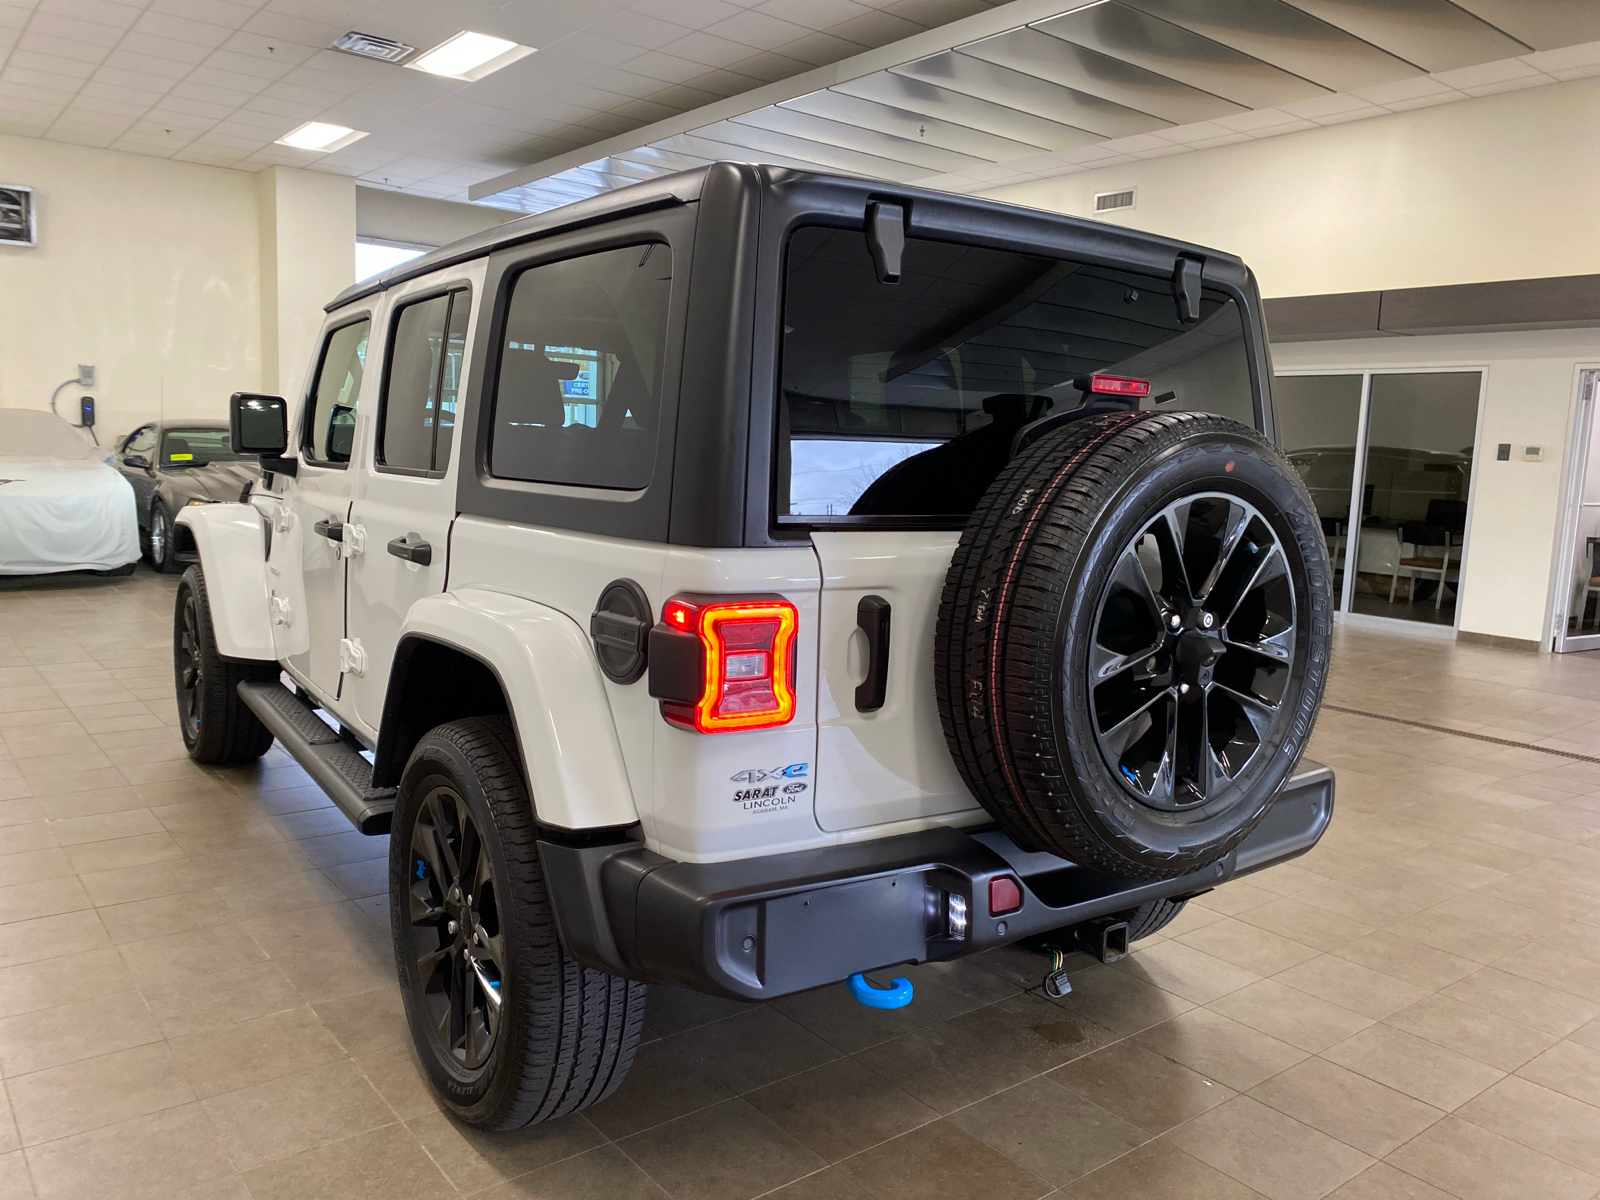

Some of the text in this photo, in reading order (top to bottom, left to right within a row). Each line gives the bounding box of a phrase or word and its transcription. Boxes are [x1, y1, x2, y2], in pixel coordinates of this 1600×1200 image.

[1281, 506, 1329, 763] BRIDGESTONE
[733, 785, 780, 802] SARAT
[743, 796, 796, 810] LINCOLN
